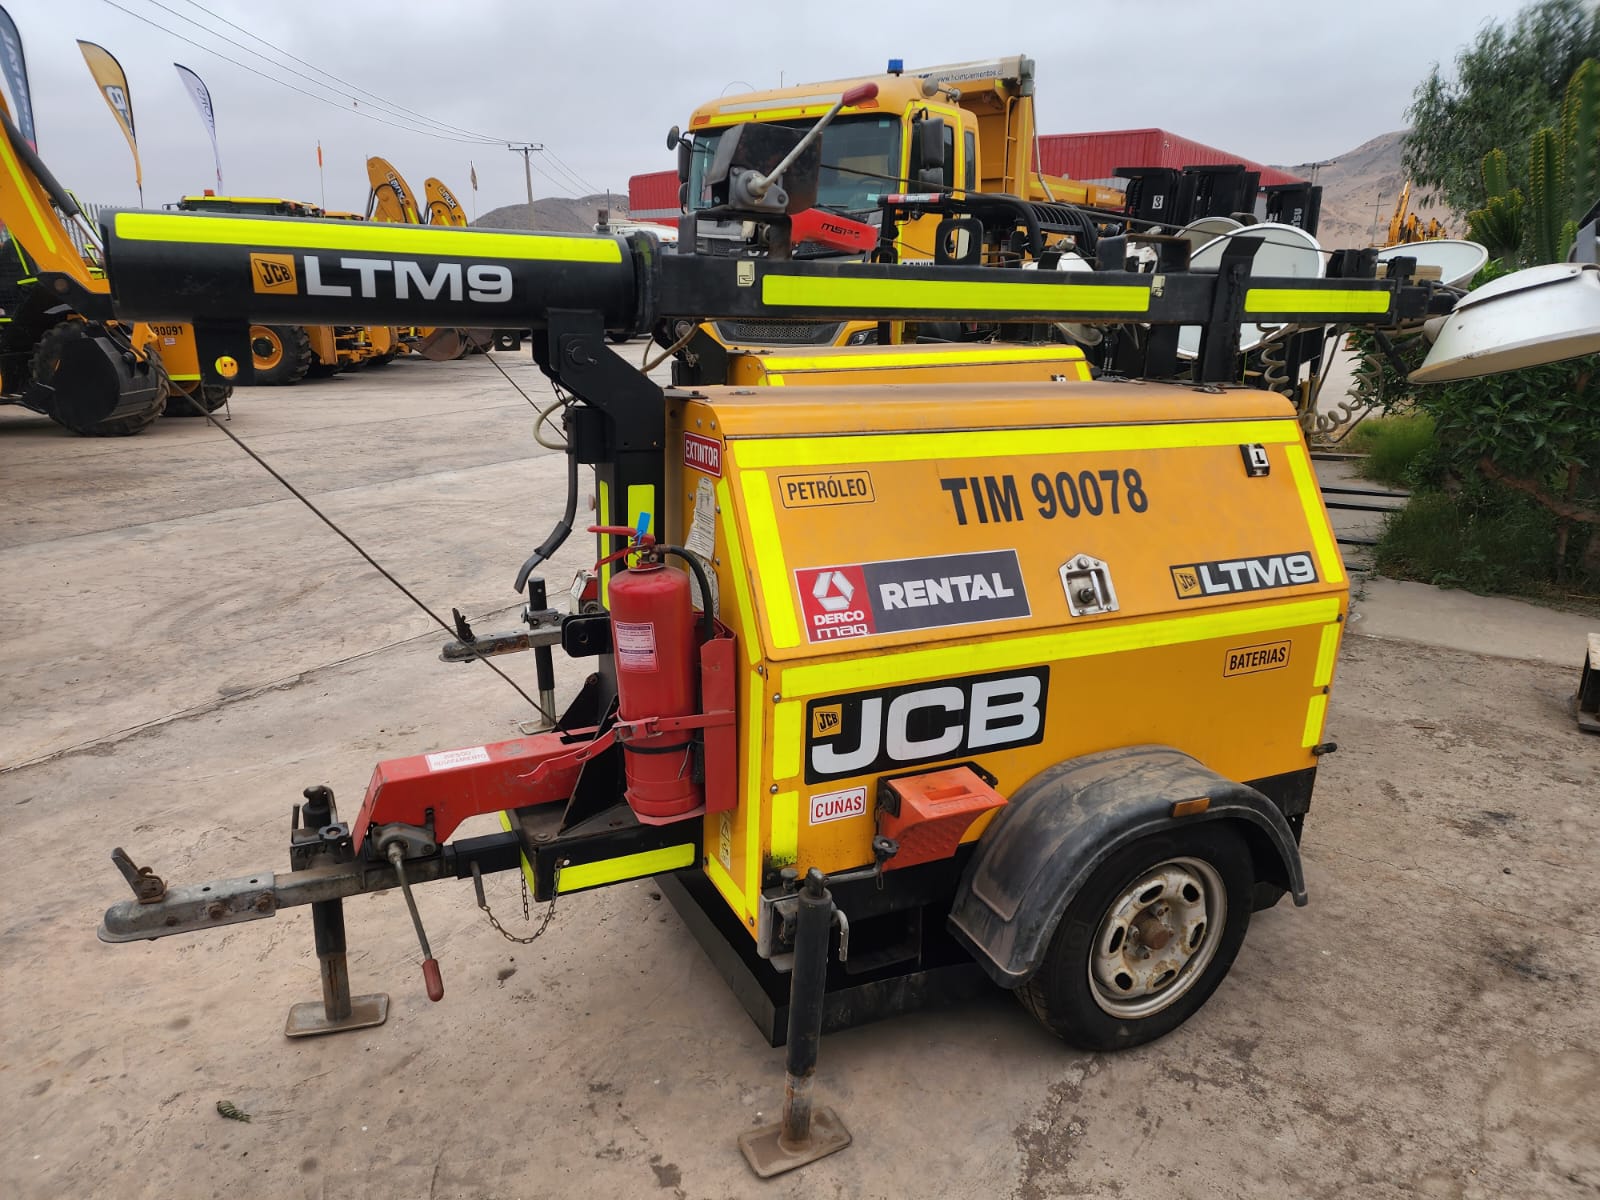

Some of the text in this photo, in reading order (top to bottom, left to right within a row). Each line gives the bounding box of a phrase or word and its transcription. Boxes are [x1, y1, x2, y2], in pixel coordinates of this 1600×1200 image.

[262, 256, 513, 303] JCB LTM9
[685, 438, 719, 469] EXTINTOR
[787, 474, 868, 501] PETRÓLEO
[940, 469, 1148, 525] TIM 90078
[1200, 555, 1316, 595] LTM9
[880, 573, 1015, 611] RENTAL
[813, 611, 865, 626] DERCO
[1229, 646, 1287, 671] BATERIAS
[811, 675, 1041, 775] JCB
[818, 711, 839, 730] JCB
[815, 796, 863, 817] CUÑAS
